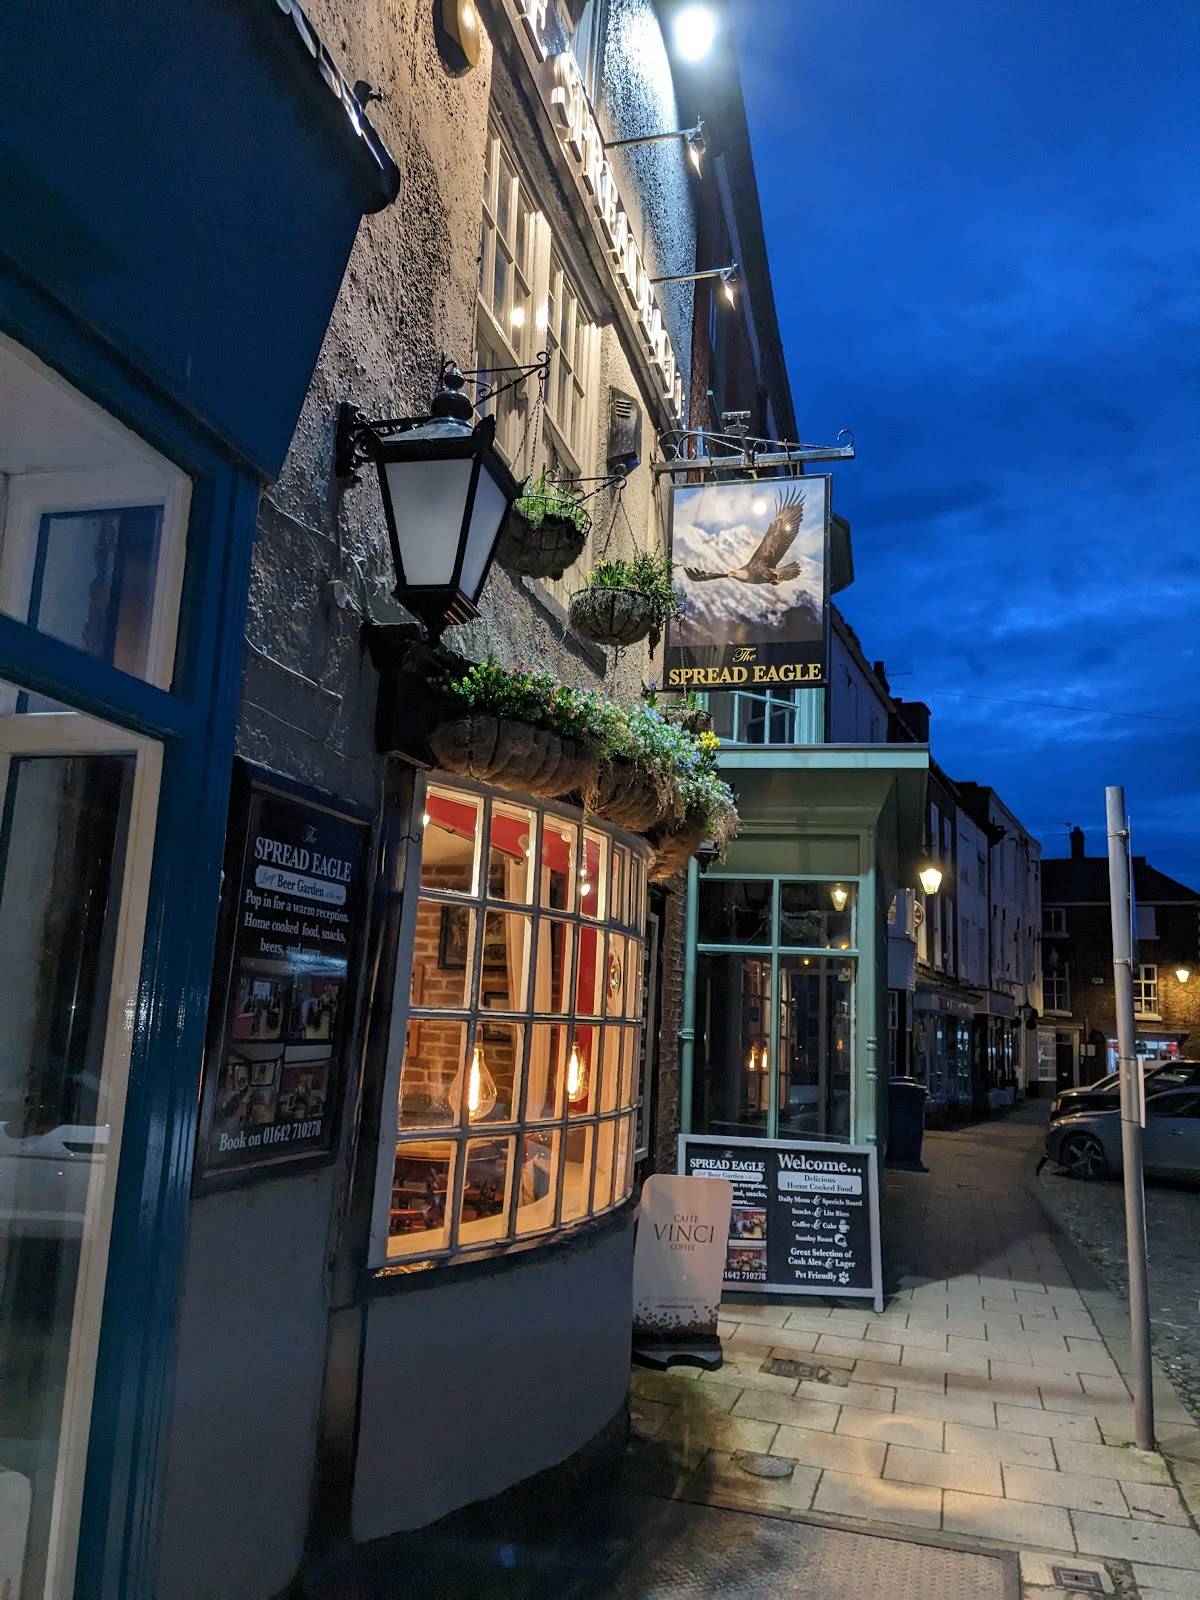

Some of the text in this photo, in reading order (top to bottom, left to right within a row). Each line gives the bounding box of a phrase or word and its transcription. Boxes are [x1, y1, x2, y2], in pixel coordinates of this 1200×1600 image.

[732, 647, 757, 663] The
[668, 663, 822, 685] SPREAD EAGLE
[254, 836, 310, 871] SPREAD
[312, 852, 352, 882] EAGLE
[277, 874, 296, 891] Beer
[297, 879, 324, 897] Garden
[245, 889, 262, 910] Pop
[263, 893, 272, 908] in
[273, 896, 285, 911] for
[286, 901, 292, 912] a
[293, 903, 315, 916] warm
[243, 912, 347, 944] Home cooked food, snacks,
[259, 937, 285, 954] beers,
[286, 943, 301, 955] and
[219, 1120, 322, 1151] Book on 01642 710278
[689, 1158, 765, 1172] SPREAD EAGLE
[777, 1153, 862, 1173] Welcome...
[722, 1172, 744, 1180] Garden
[804, 1174, 836, 1184] Delicious
[787, 1181, 853, 1193] Home Cooked Food
[778, 1195, 793, 1204] Daily
[794, 1196, 810, 1204] Menu
[811, 1195, 822, 1206] &
[822, 1198, 844, 1207] Specials
[791, 1208, 812, 1216] Snacks
[812, 1207, 823, 1218] &
[836, 1210, 850, 1218] Bites
[791, 1220, 810, 1229] Coffee
[811, 1219, 822, 1230] &
[654, 1223, 714, 1243] VINCI
[795, 1234, 833, 1244] Sunday Roast
[790, 1247, 853, 1259] Great Selection of
[788, 1257, 856, 1270] Cask Ales & Lager
[724, 1271, 767, 1281] 1642 710278
[795, 1270, 837, 1283] Pet Friendly
